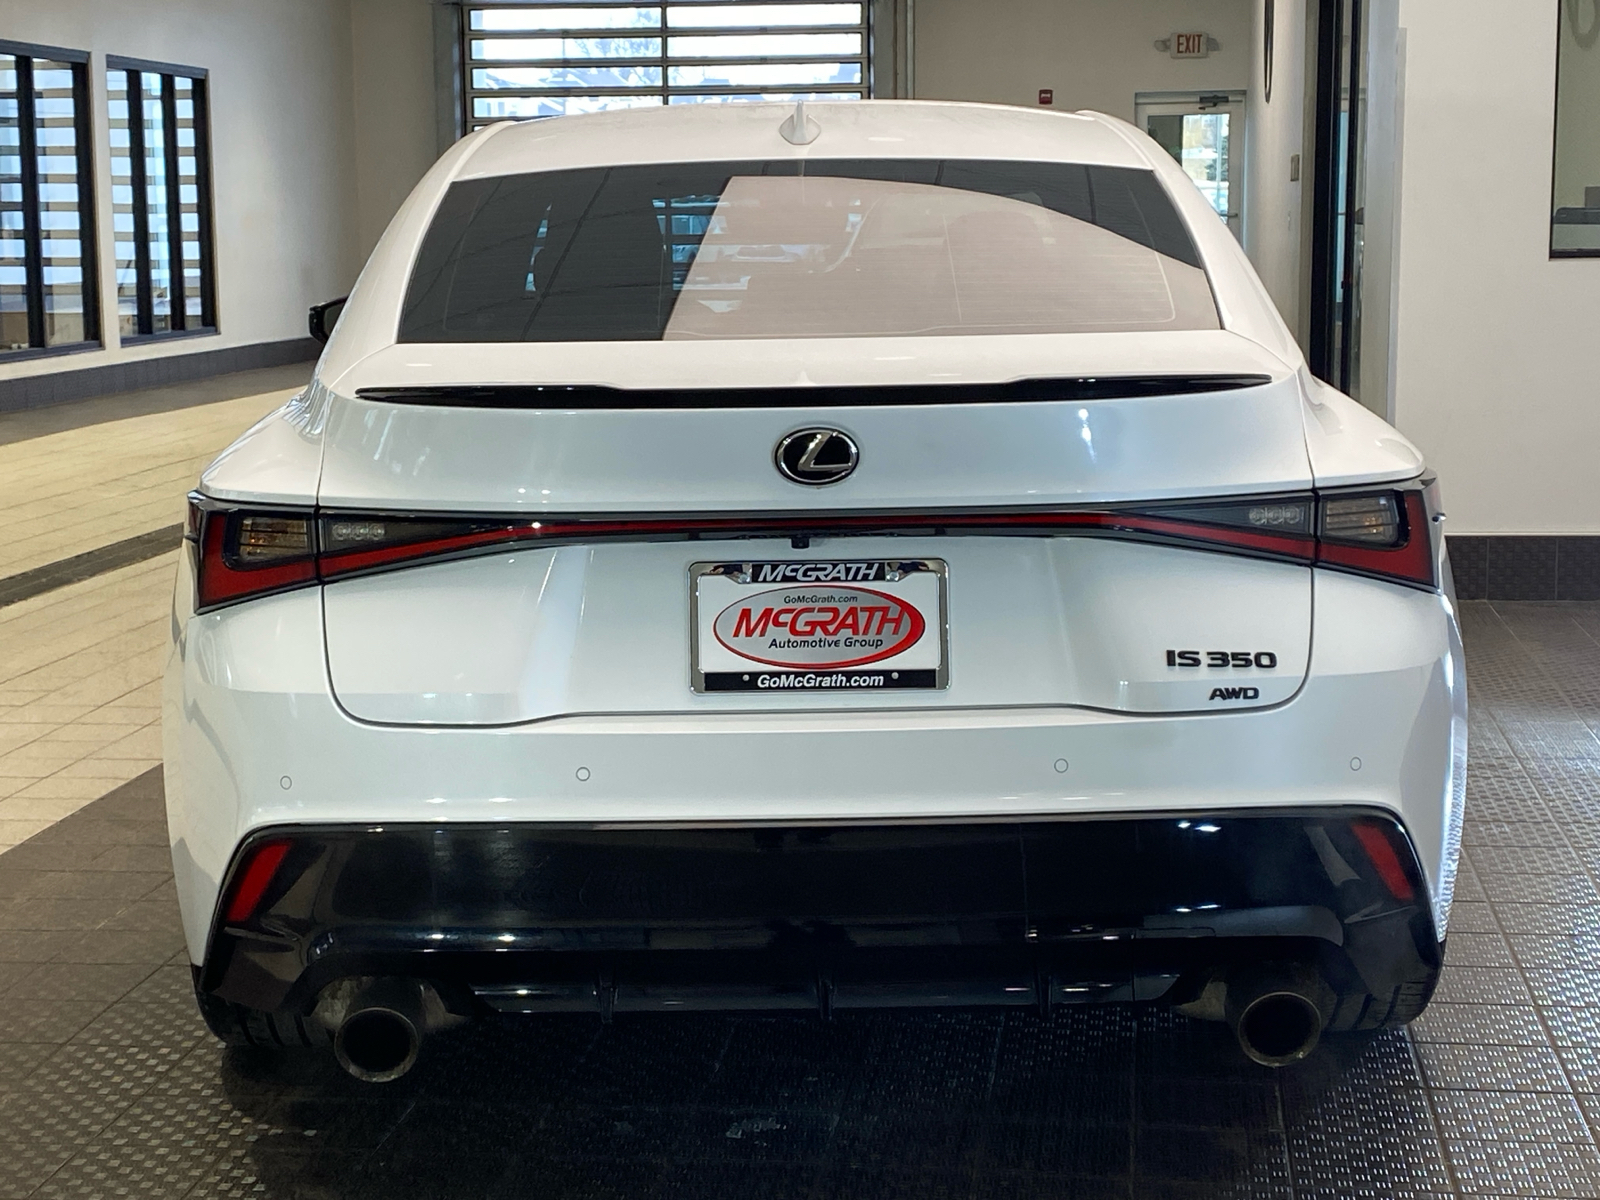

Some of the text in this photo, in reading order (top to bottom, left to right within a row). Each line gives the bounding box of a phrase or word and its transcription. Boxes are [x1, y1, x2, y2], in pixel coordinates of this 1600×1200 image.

[1176, 34, 1203, 54] EXIT
[783, 594, 858, 604] GoMcGrath.com
[768, 637, 883, 650] Automotive Group
[1166, 649, 1278, 669] IS 350
[757, 673, 884, 688] GoMcGrath.com
[1209, 686, 1260, 701] AWD
